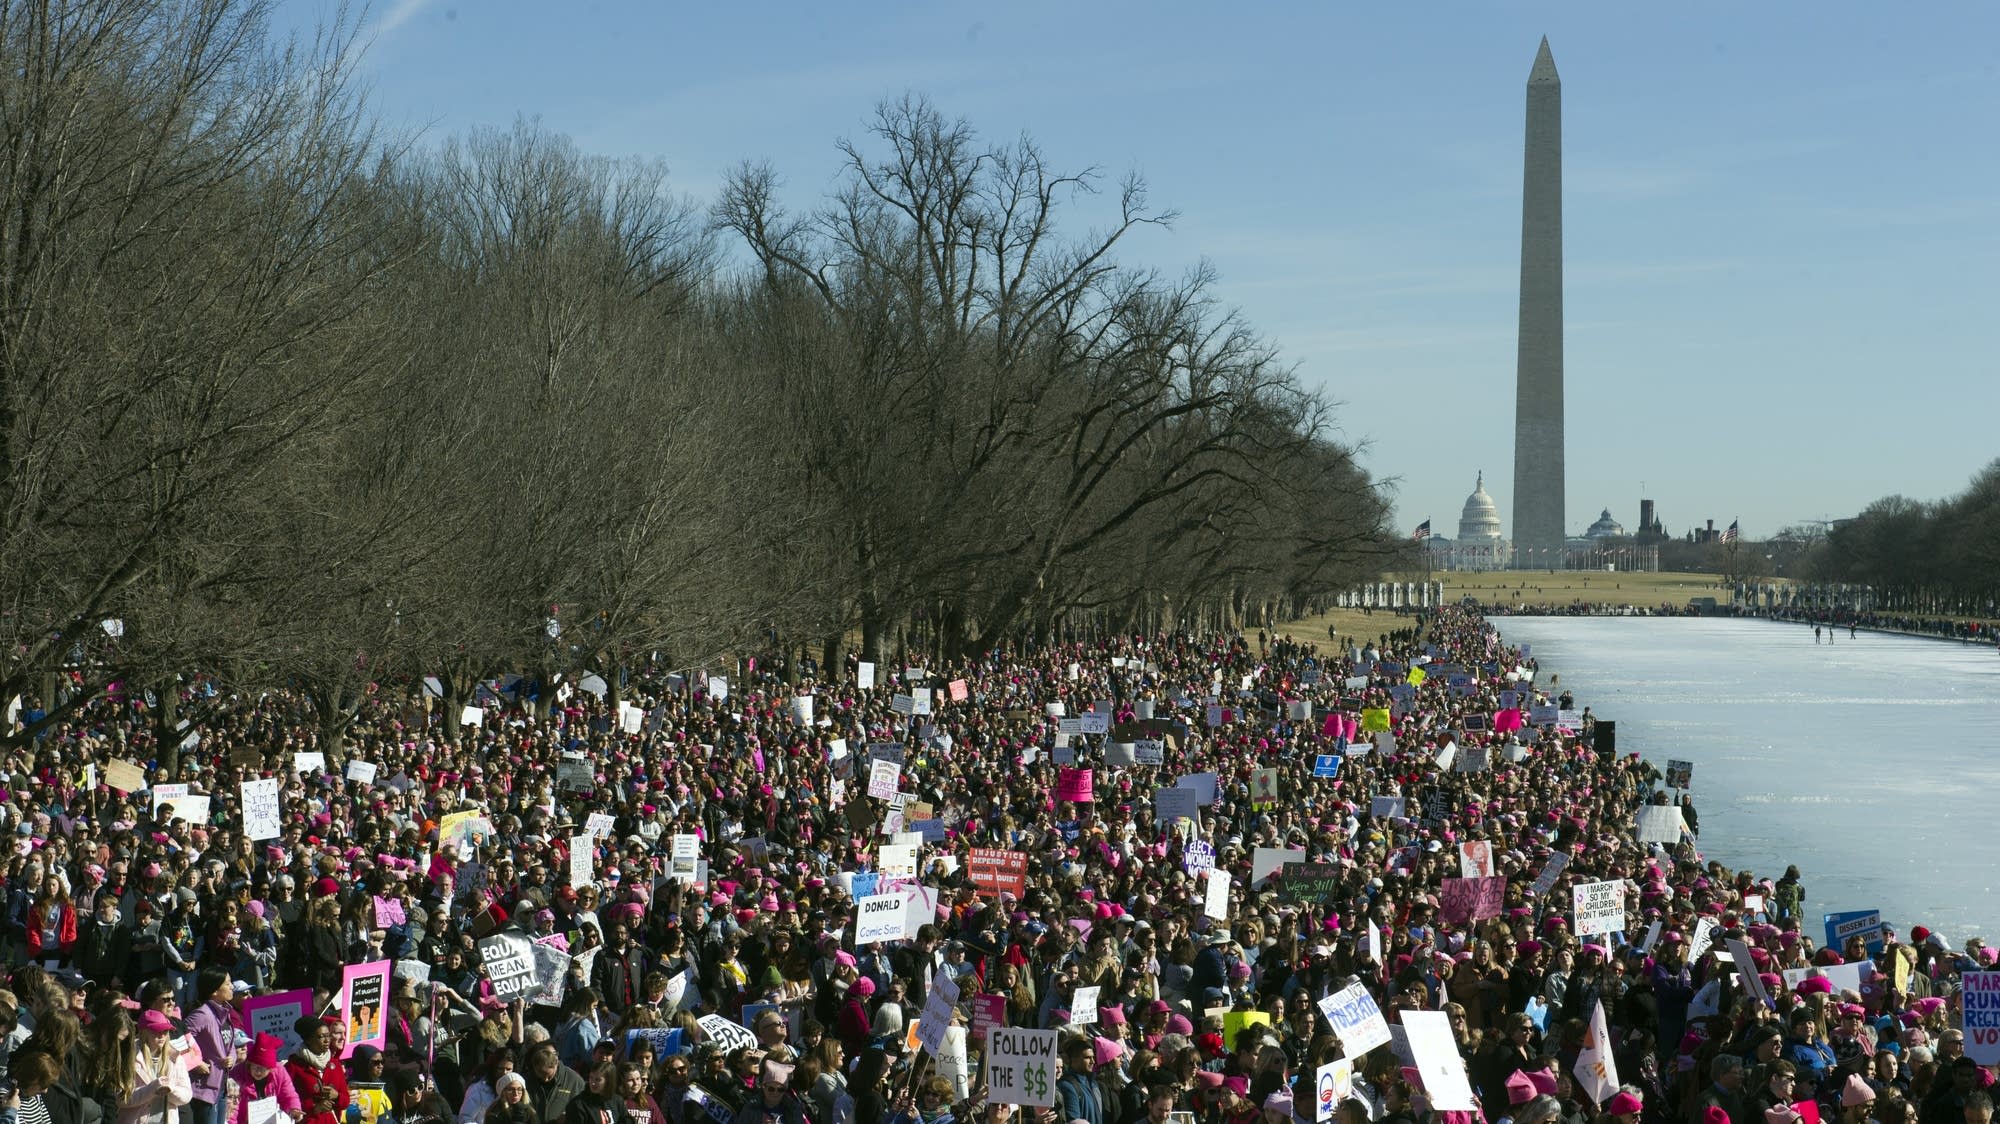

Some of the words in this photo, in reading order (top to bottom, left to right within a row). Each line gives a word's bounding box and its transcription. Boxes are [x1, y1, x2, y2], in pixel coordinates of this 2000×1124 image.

[872, 780, 895, 790] EXPECT
[1424, 787, 1450, 803] WE
[250, 803, 273, 814] WITH
[907, 802, 918, 810] MY
[254, 810, 269, 820] HER
[574, 837, 589, 848] YOU
[1190, 840, 1213, 855] ELECT
[975, 849, 1025, 860] INJUSTICE
[1185, 852, 1216, 868] WOMEN
[972, 857, 1006, 866] DEPENDS
[1010, 860, 1022, 868] ON
[1300, 865, 1318, 877] Year
[972, 873, 993, 881] BEING
[996, 875, 1019, 883] QUIET
[1313, 879, 1335, 892] Still
[1448, 879, 1498, 897] MARCH
[1590, 883, 1613, 893] MARCH
[1589, 893, 1599, 902] SO
[1601, 892, 1610, 901] MY
[864, 899, 900, 913] DONALD
[1585, 900, 1616, 911] CHILDREN
[1598, 908, 1615, 918] HAVE
[1614, 907, 1623, 916] TO
[860, 925, 882, 938] Comic
[883, 923, 902, 935] Sans
[1839, 919, 1866, 934] DISSENT
[1869, 916, 1876, 926] IS
[493, 974, 541, 996] EQUAL
[1327, 994, 1380, 1032] TOLERATE
[712, 1023, 751, 1055] ERA
[1973, 1029, 2000, 1045] VO
[993, 1031, 1053, 1058] FOLLOW
[991, 1065, 1013, 1089] THE
[1023, 1061, 1048, 1100] $$
